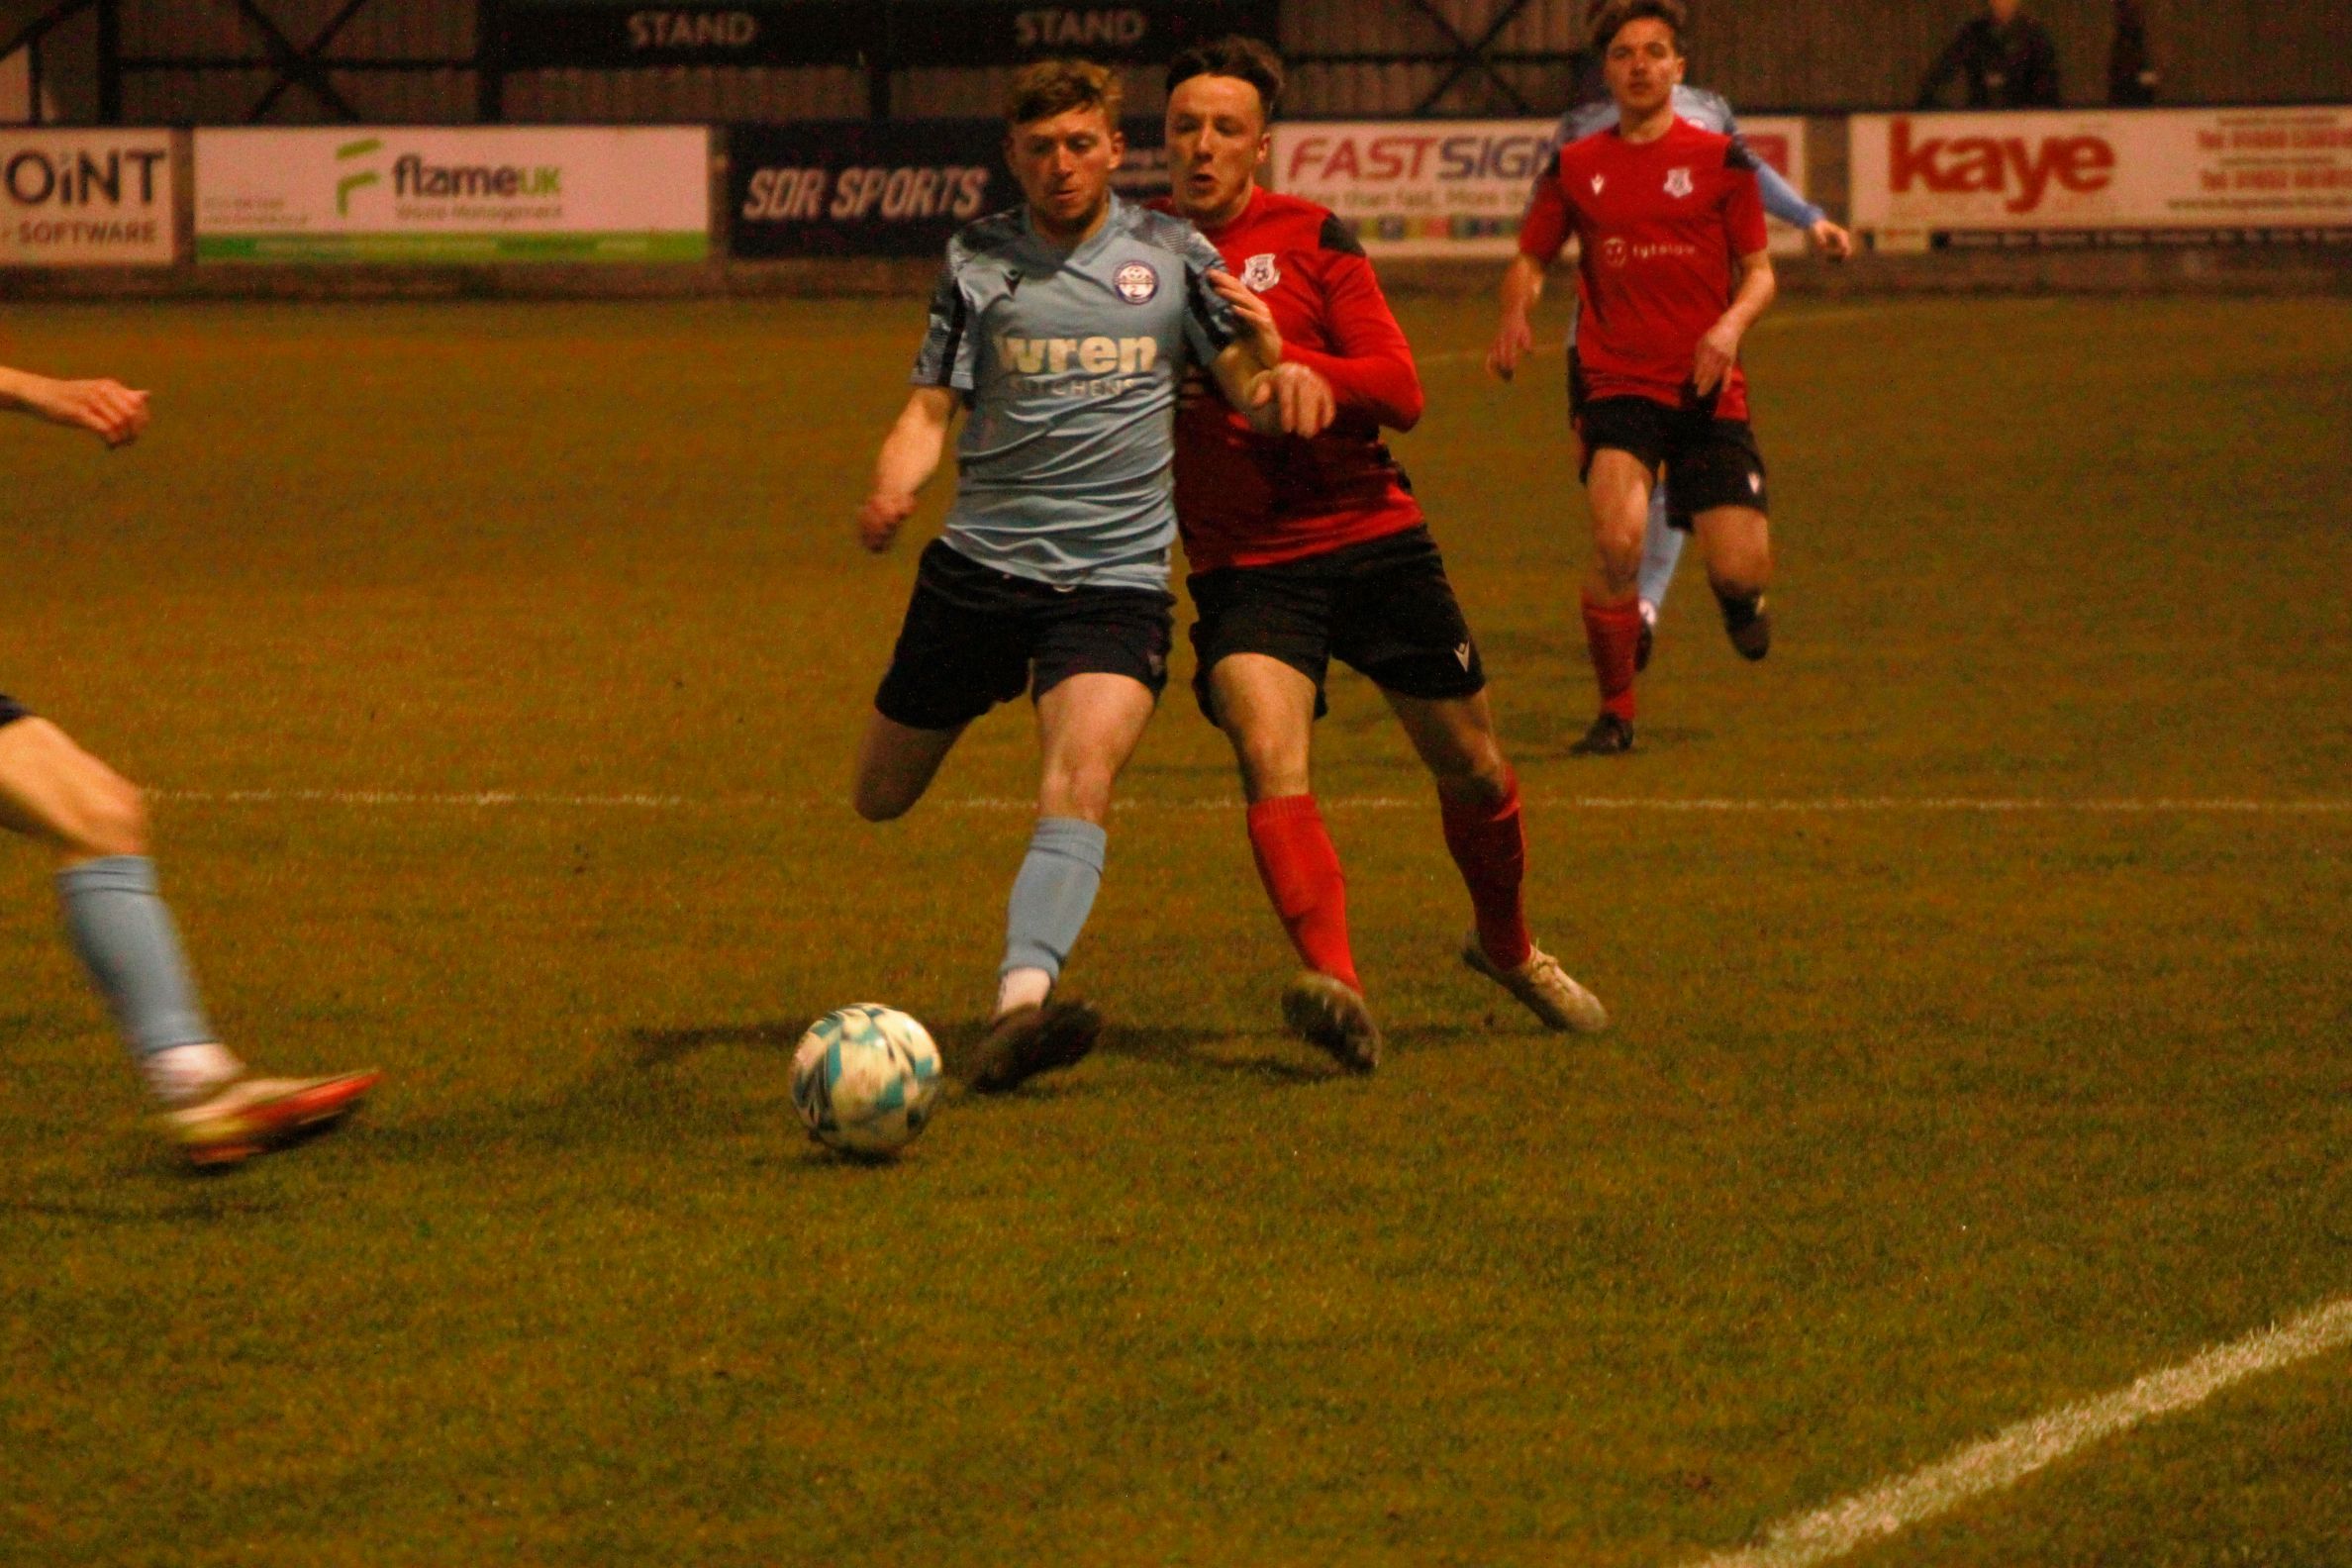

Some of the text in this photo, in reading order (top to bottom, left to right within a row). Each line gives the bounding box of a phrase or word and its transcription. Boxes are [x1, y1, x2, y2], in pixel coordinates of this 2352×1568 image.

[627, 11, 757, 48] STAND
[1015, 10, 1146, 48] STAND
[1889, 115, 2114, 213] kaye
[831, 166, 987, 219] SPORTS
[19, 220, 155, 244] SOFTWARE
[995, 336, 1157, 373] wren
